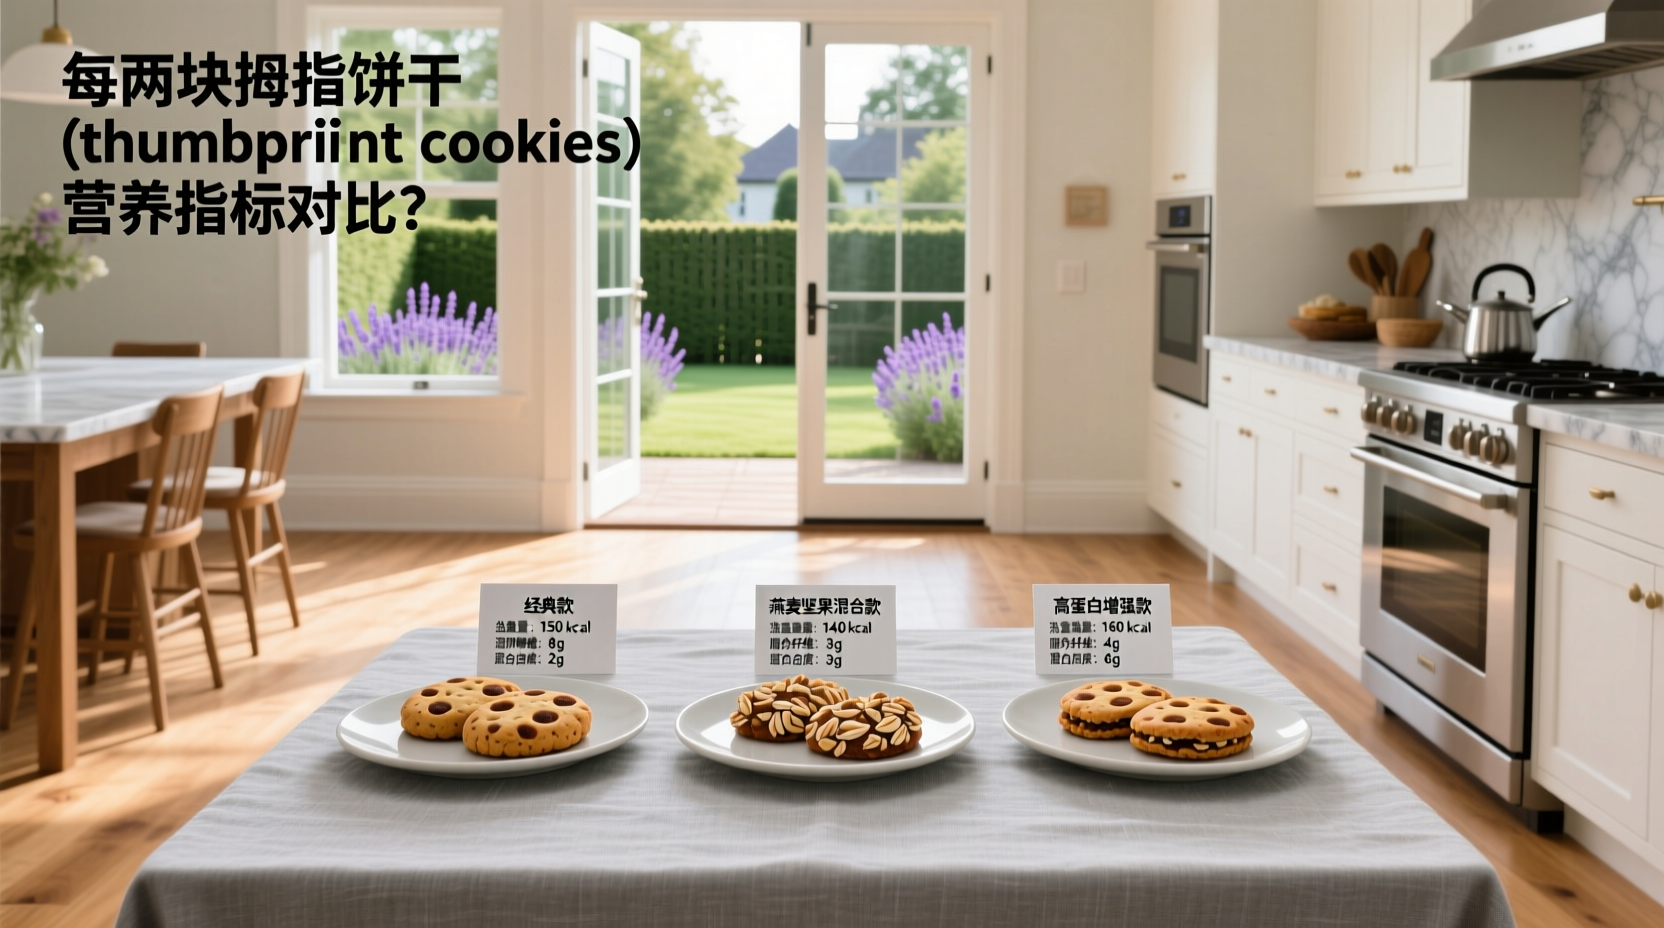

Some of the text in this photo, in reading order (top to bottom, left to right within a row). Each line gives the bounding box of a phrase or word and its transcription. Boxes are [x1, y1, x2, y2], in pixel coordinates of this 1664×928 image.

[523, 596, 574, 615] 经典款
[768, 596, 882, 616] 燕麦坚果混合款
[1053, 596, 1152, 616] 高蛋白增强款
[540, 620, 563, 633] 150
[566, 620, 591, 634] kcal
[822, 621, 846, 634] 140
[848, 620, 872, 634] kcal
[1102, 621, 1124, 633] 160
[1127, 621, 1152, 634] kcal
[548, 652, 565, 668] 2g
